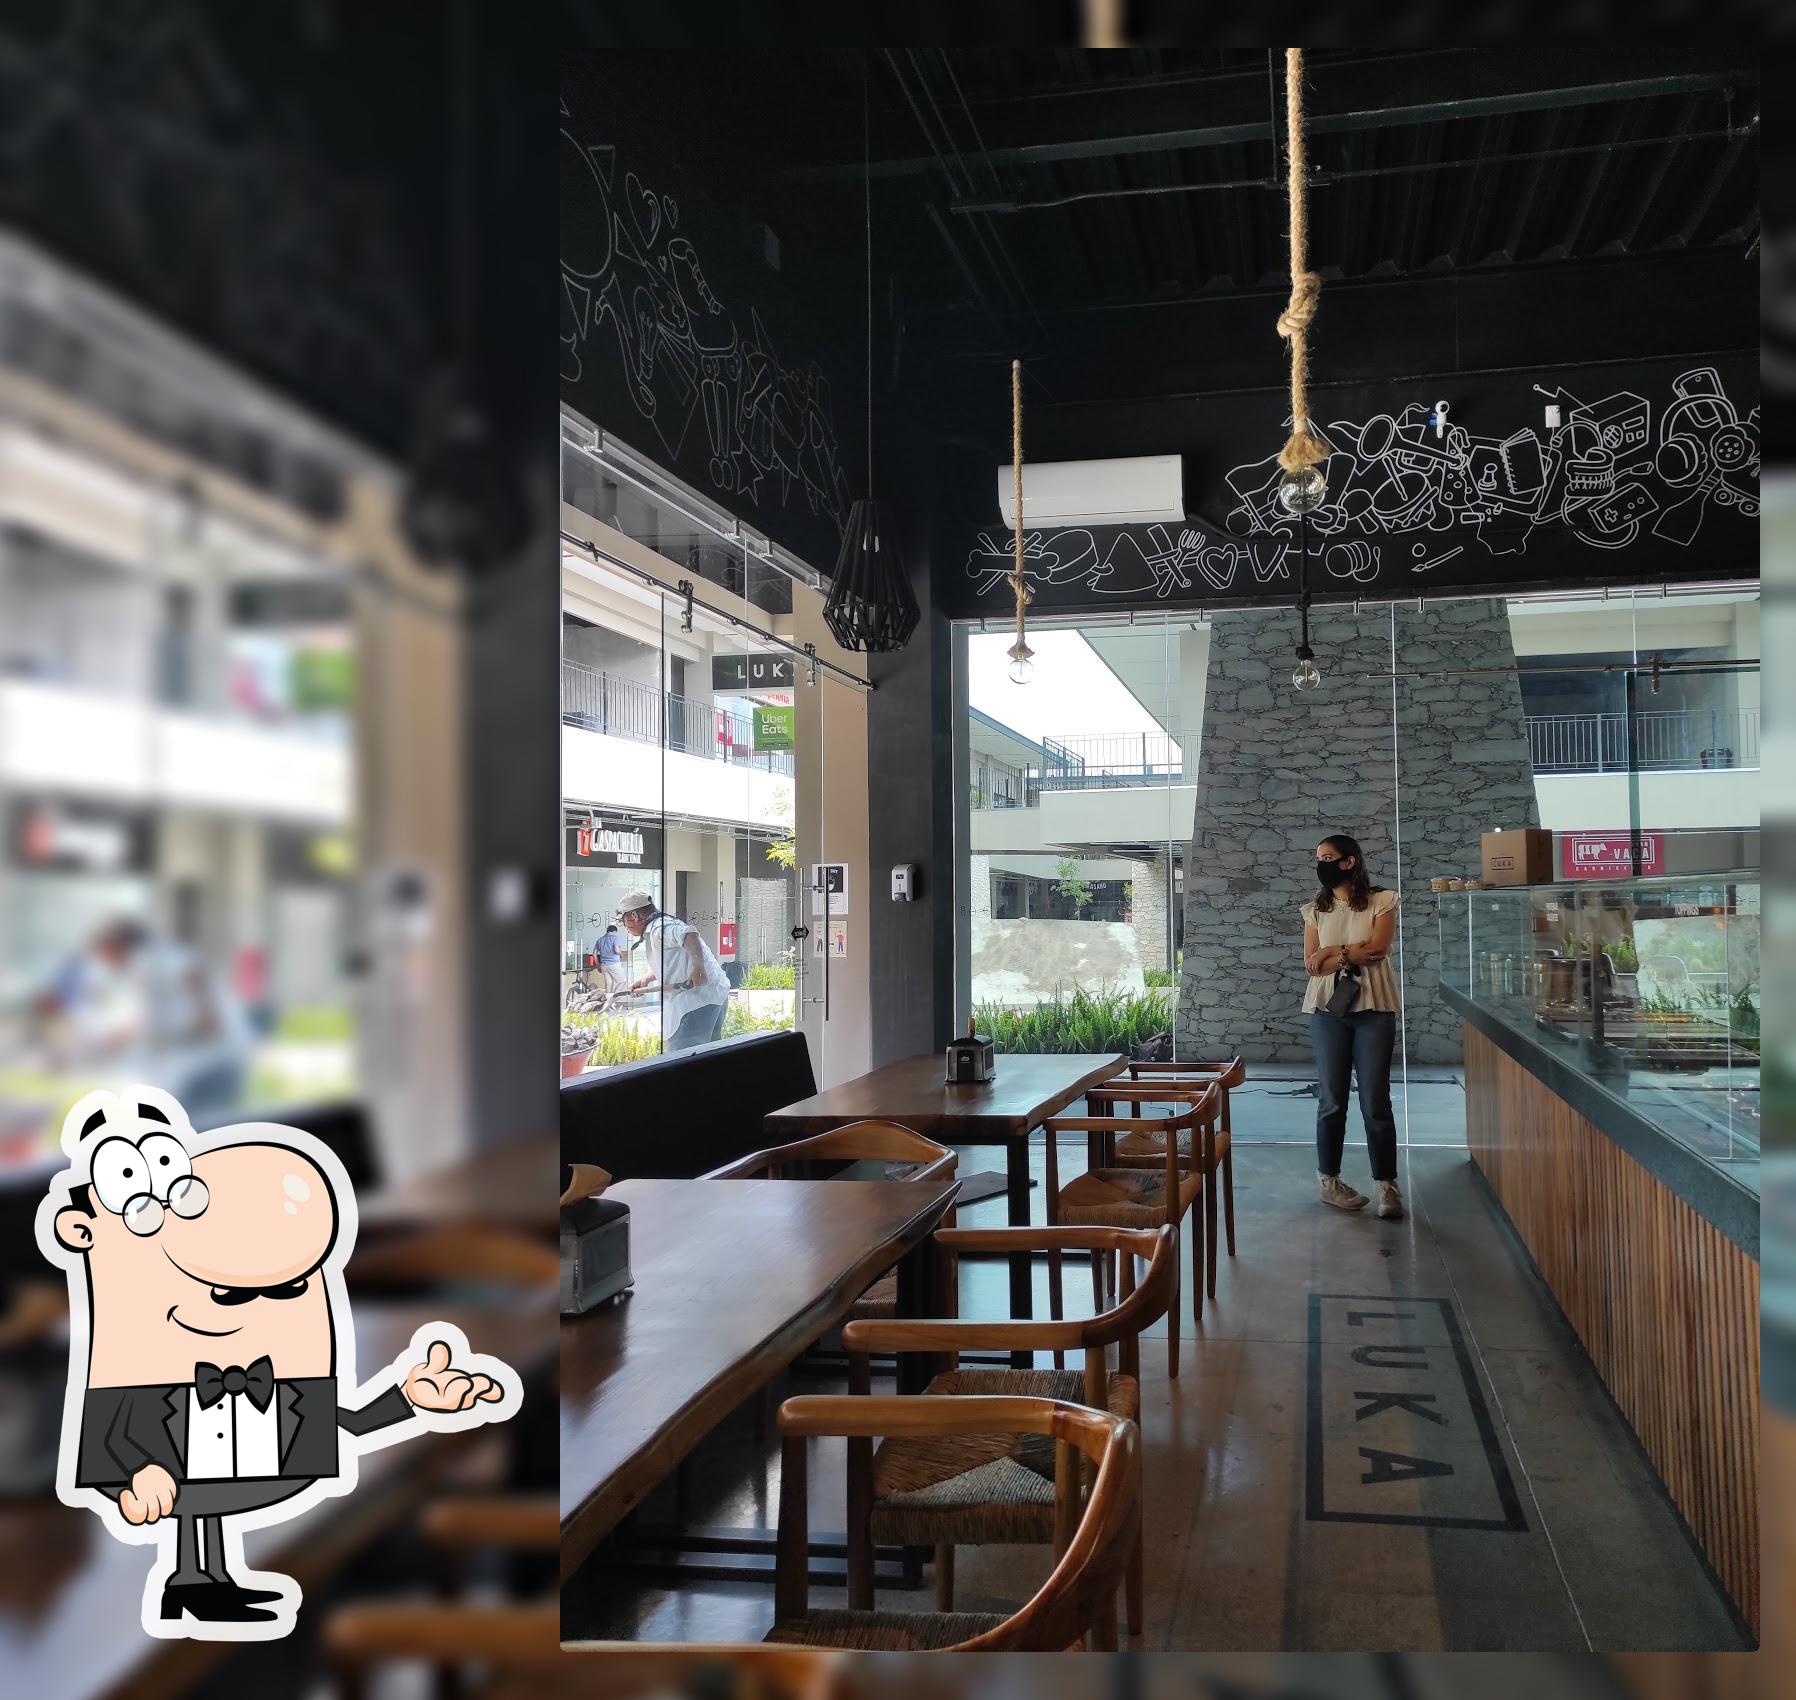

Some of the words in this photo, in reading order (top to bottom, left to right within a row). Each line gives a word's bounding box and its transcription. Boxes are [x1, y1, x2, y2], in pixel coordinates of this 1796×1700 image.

[737, 663, 795, 679] LUK
[761, 713, 788, 724] Uber
[762, 725, 788, 735] Eats
[1346, 1311, 1455, 1484] LUKA
